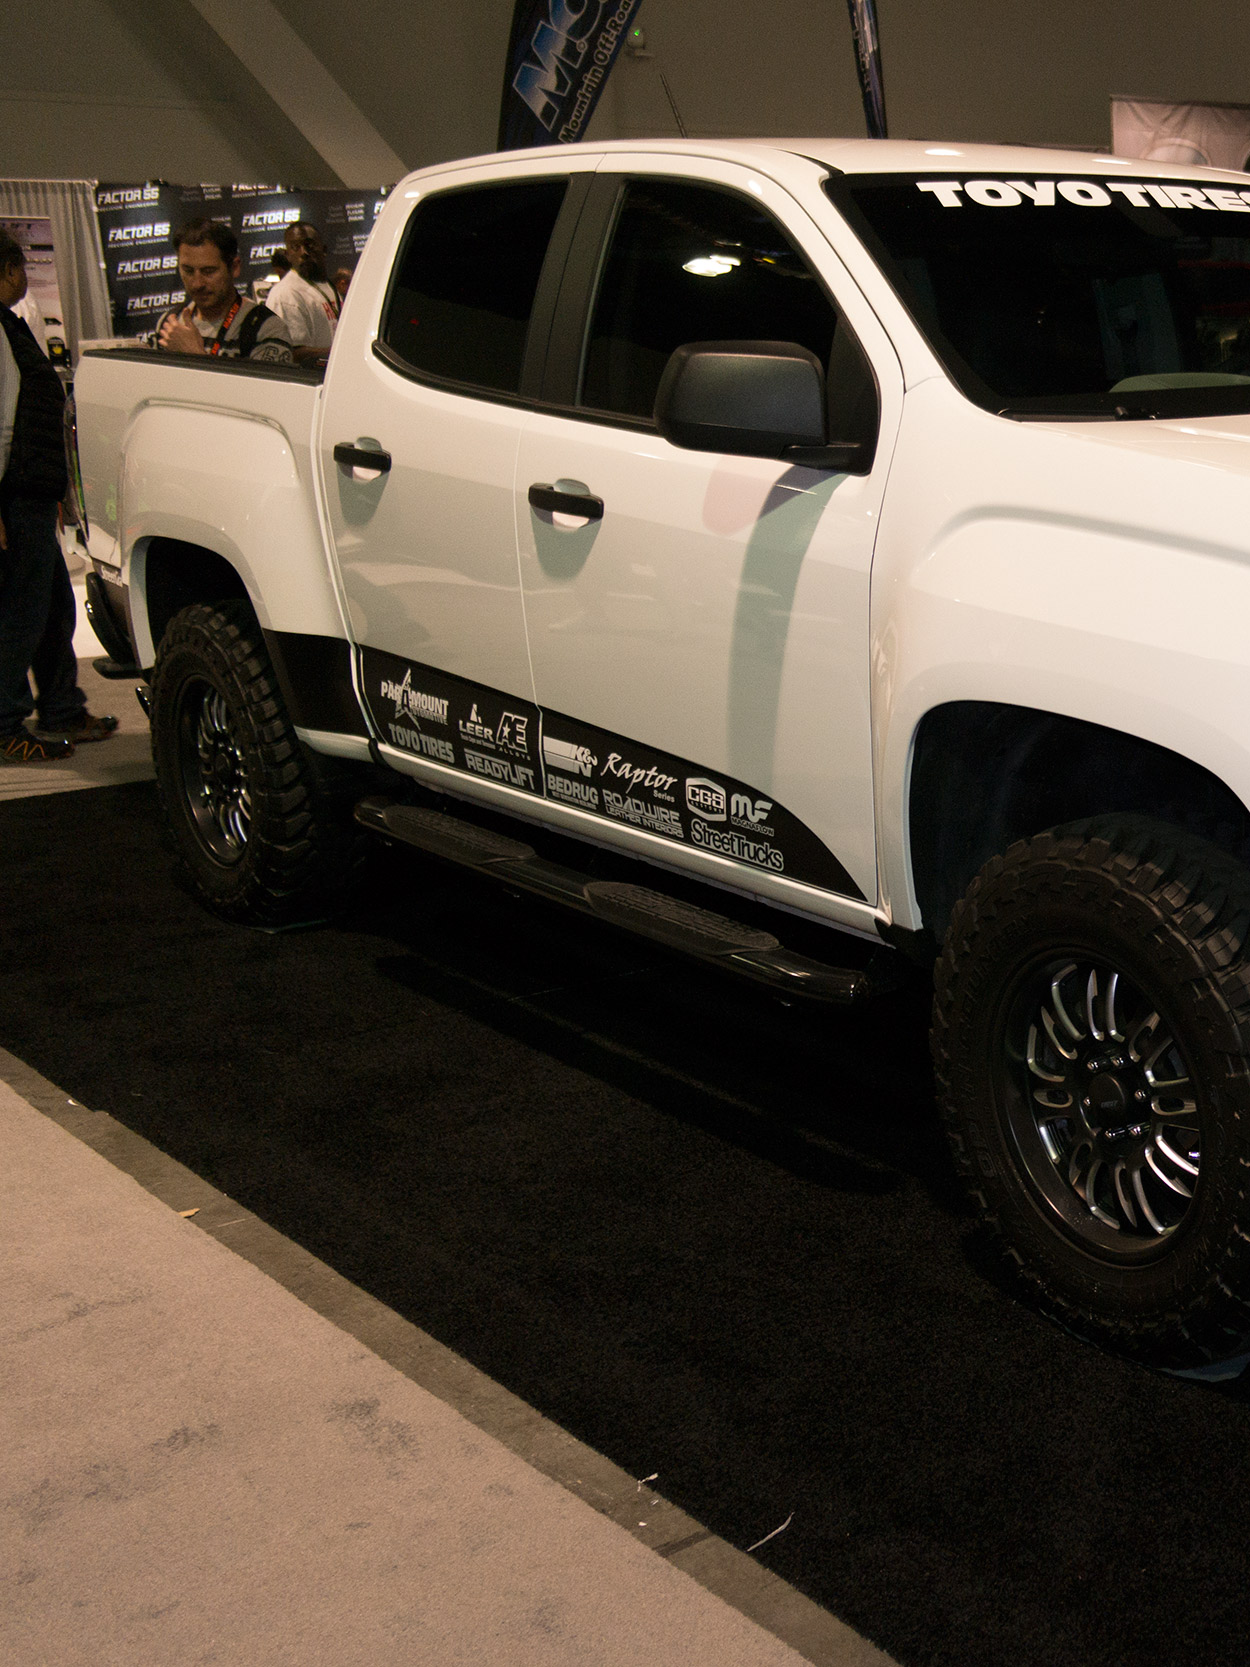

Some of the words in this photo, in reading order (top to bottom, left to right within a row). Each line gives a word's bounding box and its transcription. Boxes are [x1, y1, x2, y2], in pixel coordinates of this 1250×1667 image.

[558, 66, 604, 143] Mountain
[97, 190, 142, 205] FACTOR
[143, 187, 160, 200] 55
[915, 180, 1112, 208] TOYO
[241, 210, 284, 227] FACTOR
[108, 225, 153, 242] FACTOR
[154, 222, 171, 237] 55
[250, 243, 287, 259] FACT
[117, 258, 161, 275] FACTOR
[161, 255, 178, 269] 55
[127, 294, 170, 311] FACTOR
[170, 291, 186, 305] 55
[381, 678, 449, 717] PARAMOUNT
[458, 719, 494, 742] LEER
[388, 722, 421, 753] TOYO
[419, 733, 455, 765] TIRES
[498, 747, 532, 761] ALLOYS
[465, 752, 536, 791] READYLIFT
[600, 752, 678, 794] Raptor
[547, 773, 599, 805] BEDRUG
[653, 790, 676, 803] Series
[688, 785, 724, 810] CGS
[602, 788, 682, 826] ROADWIRE
[605, 804, 643, 826] LEATHER
[643, 816, 685, 839] INTERIORS
[730, 816, 775, 837] MAGNAFLOW
